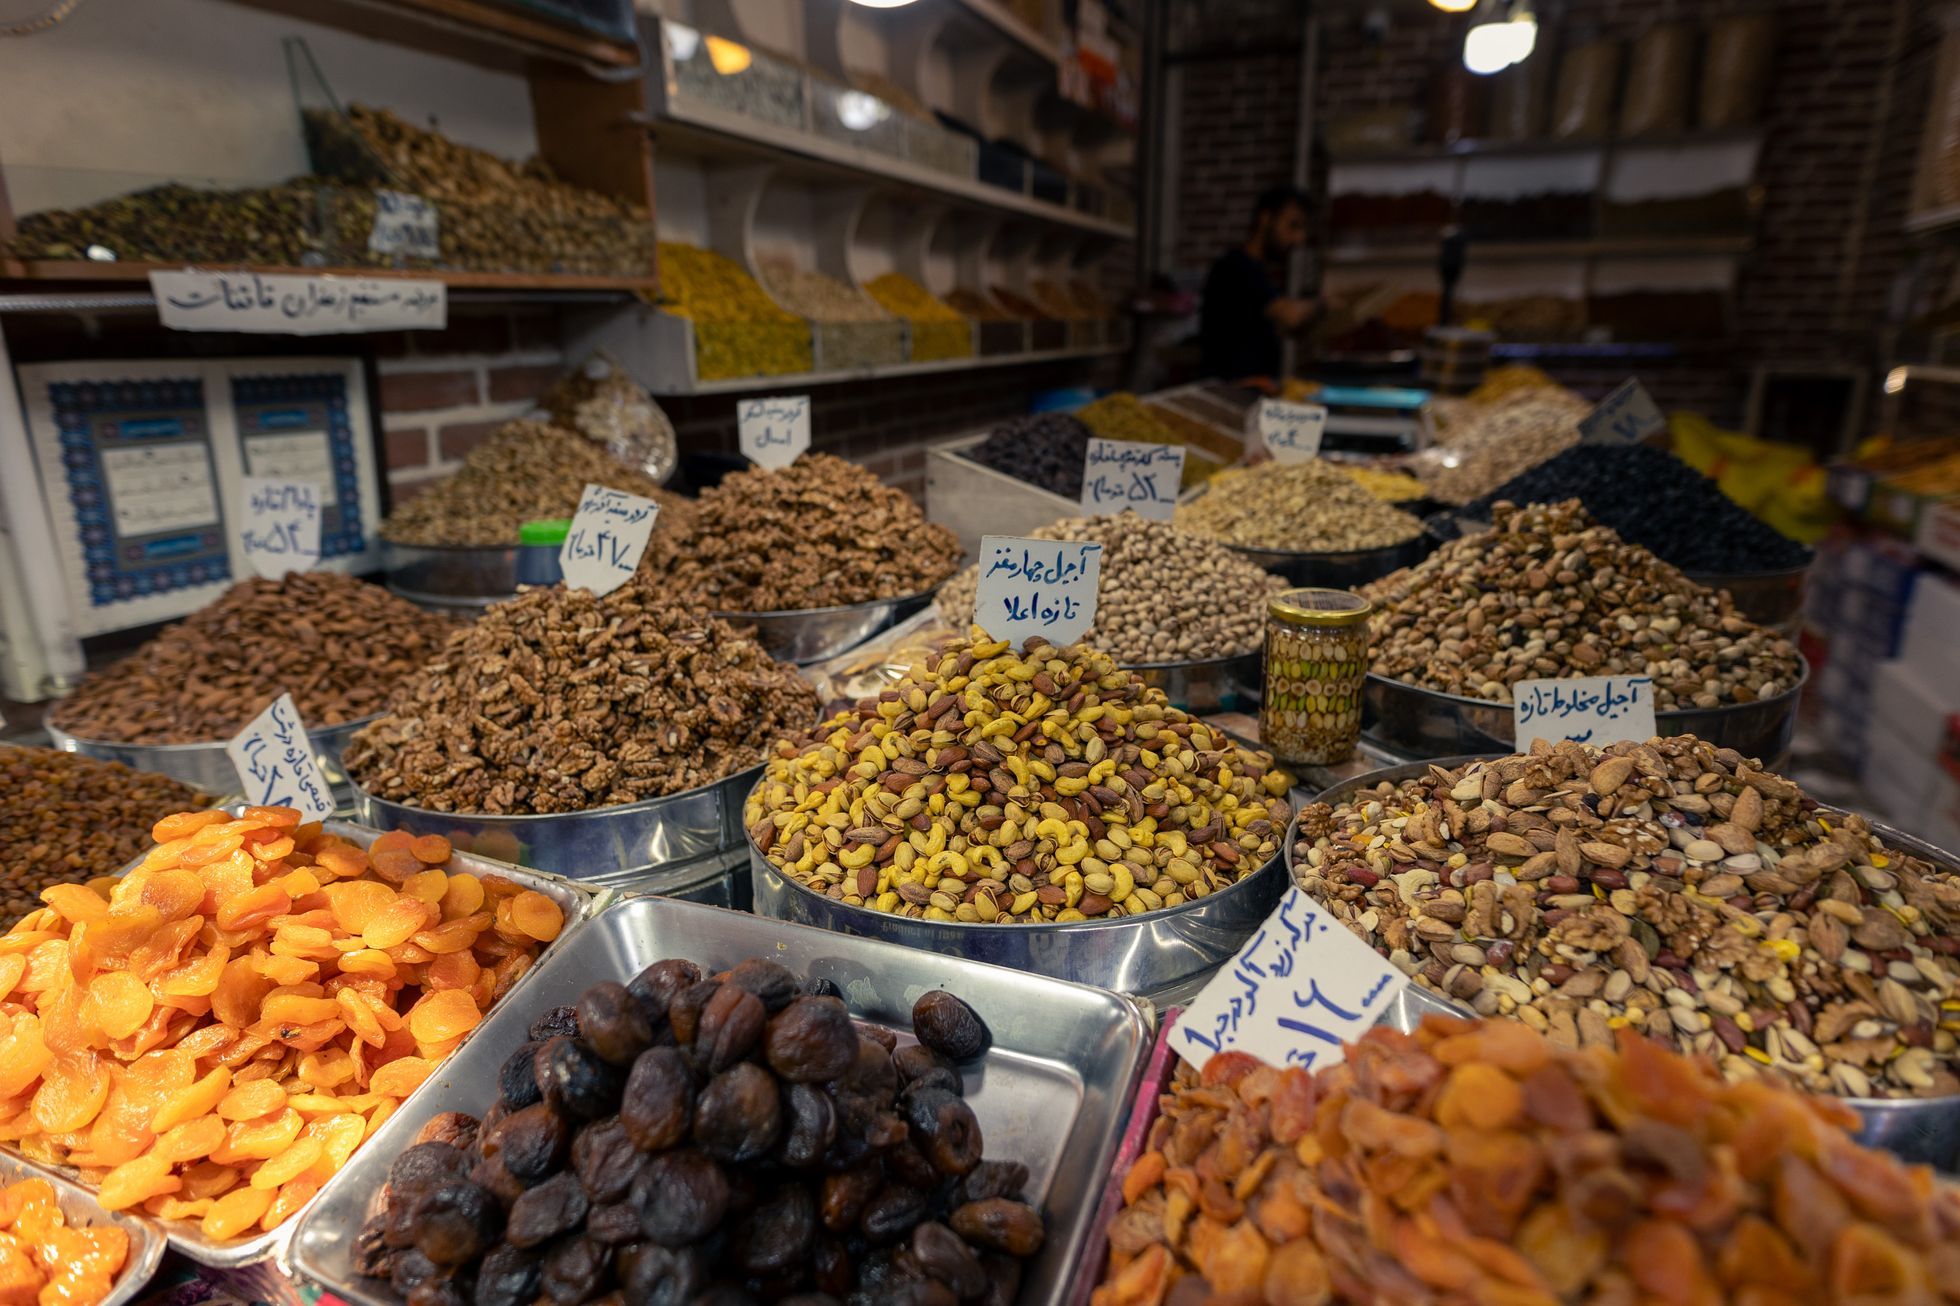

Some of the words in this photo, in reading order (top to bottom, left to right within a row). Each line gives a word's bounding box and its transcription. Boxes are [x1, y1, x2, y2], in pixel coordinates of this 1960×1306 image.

[281, 281, 348, 318] زعفران
[1044, 545, 1101, 585] آجیل
[1003, 592, 1039, 622] اعلا
[1043, 596, 1081, 627] تازه
[1519, 686, 1552, 724] تازه
[1550, 686, 1600, 718] مخلوط
[1596, 678, 1652, 719] آجیل
[283, 747, 314, 777] تازه
[1279, 889, 1328, 952] برگه
